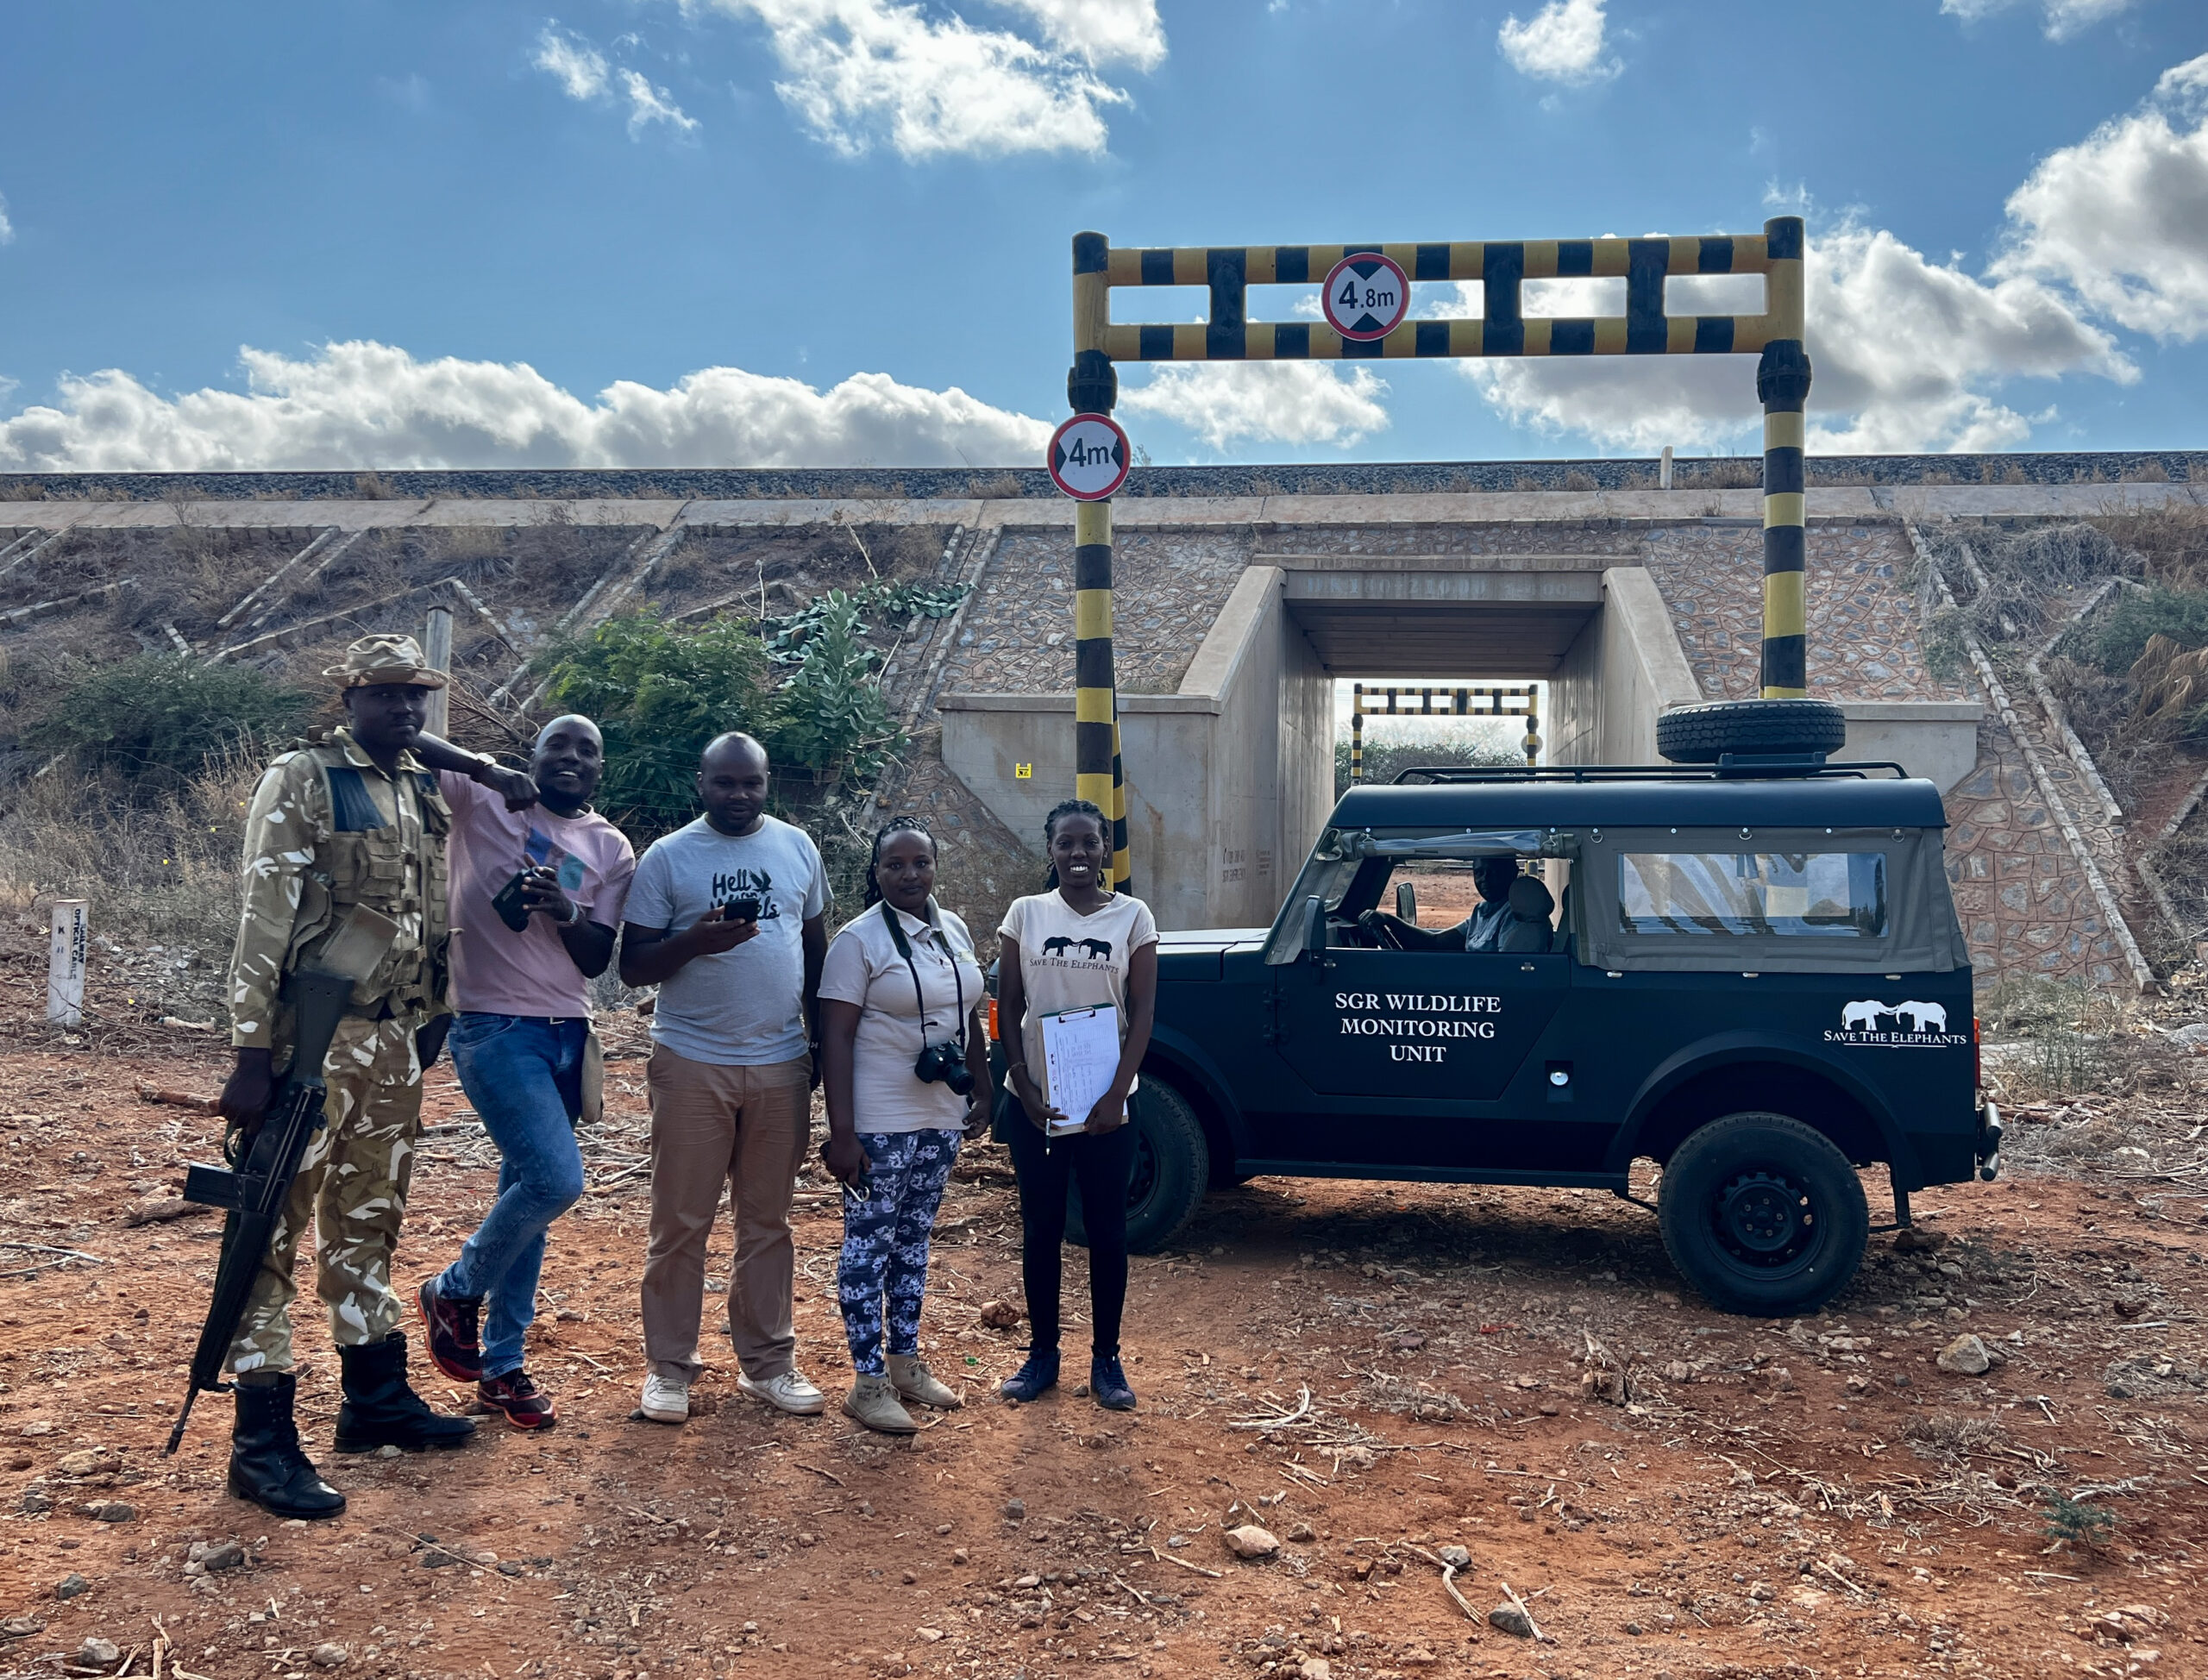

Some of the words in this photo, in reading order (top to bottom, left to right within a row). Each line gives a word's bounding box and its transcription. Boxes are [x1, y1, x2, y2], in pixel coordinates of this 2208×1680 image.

[1339, 280, 1395, 310] 4.8m
[1069, 437, 1109, 467] 4m
[1335, 993, 1380, 1009] SGR
[1385, 994, 1502, 1012] WILDLIFE
[1340, 1018, 1495, 1038] MONITORING
[1823, 1030, 1856, 1042] SAVE
[1860, 1031, 1888, 1042] THE
[1891, 1031, 1967, 1044] ELEPHANTS
[1389, 1044, 1446, 1063] UNIT
